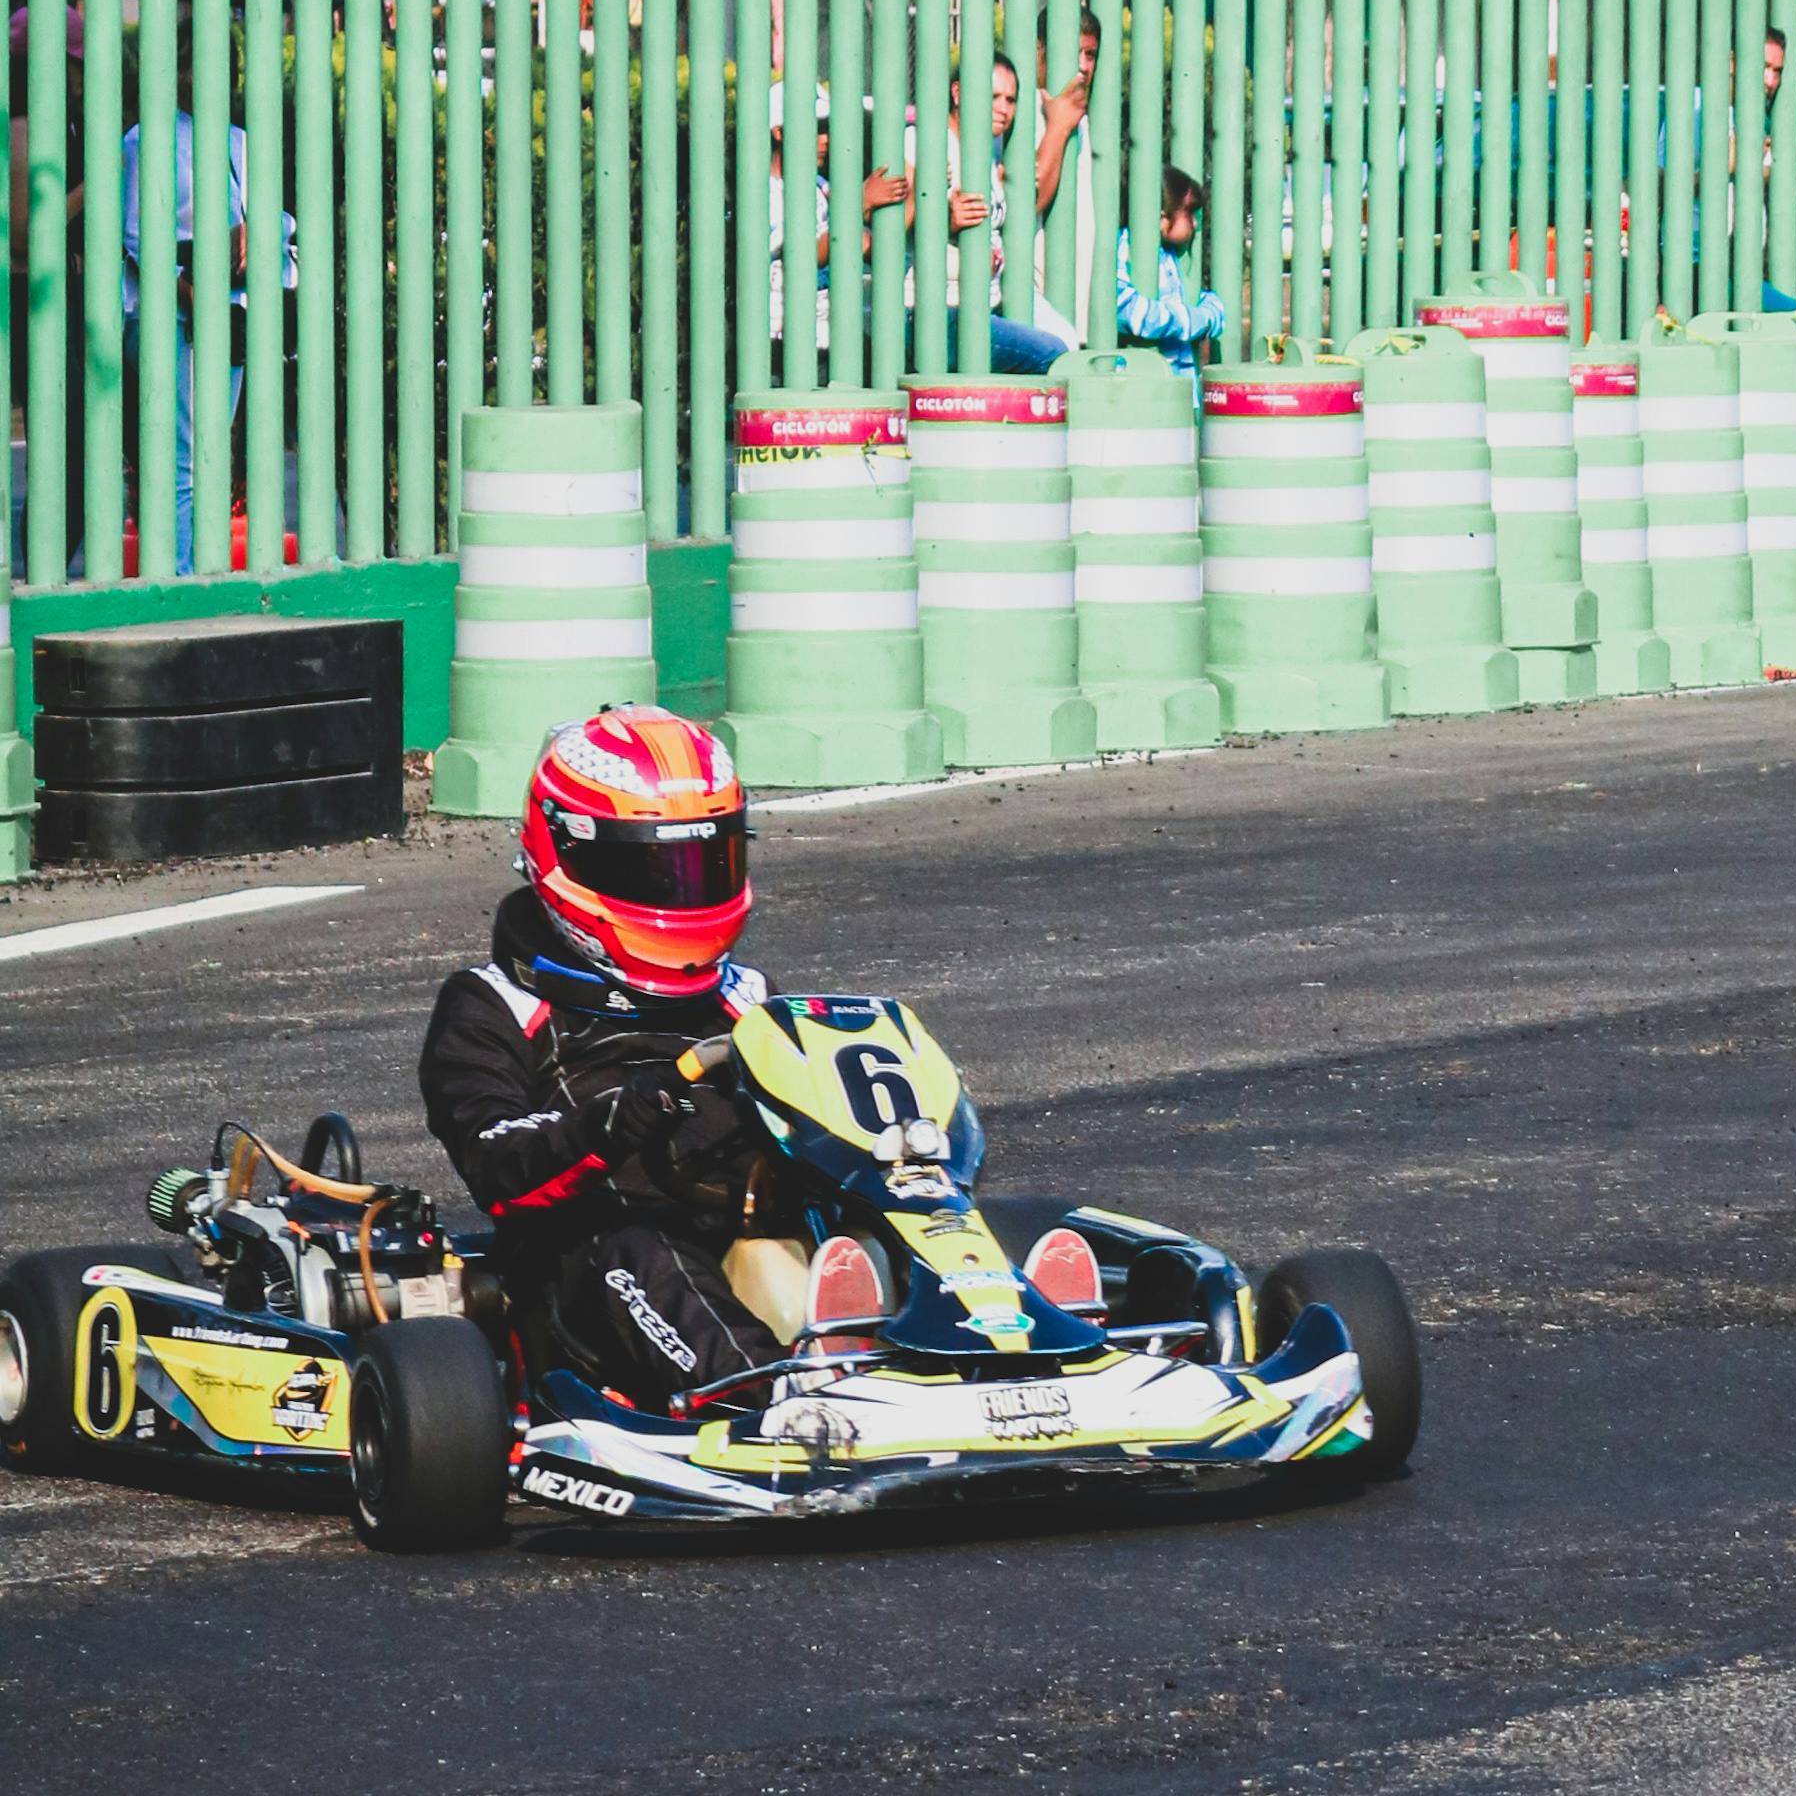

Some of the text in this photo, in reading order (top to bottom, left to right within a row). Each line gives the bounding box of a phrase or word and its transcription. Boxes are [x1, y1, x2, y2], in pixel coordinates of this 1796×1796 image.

[915, 396, 987, 412] CICLOTÓN
[772, 419, 851, 435] CICLOTÓN
[835, 1042, 923, 1136] 6
[86, 1301, 122, 1435] 6
[978, 1386, 1071, 1421] FRIENDS
[522, 1466, 636, 1517] MEXICO
